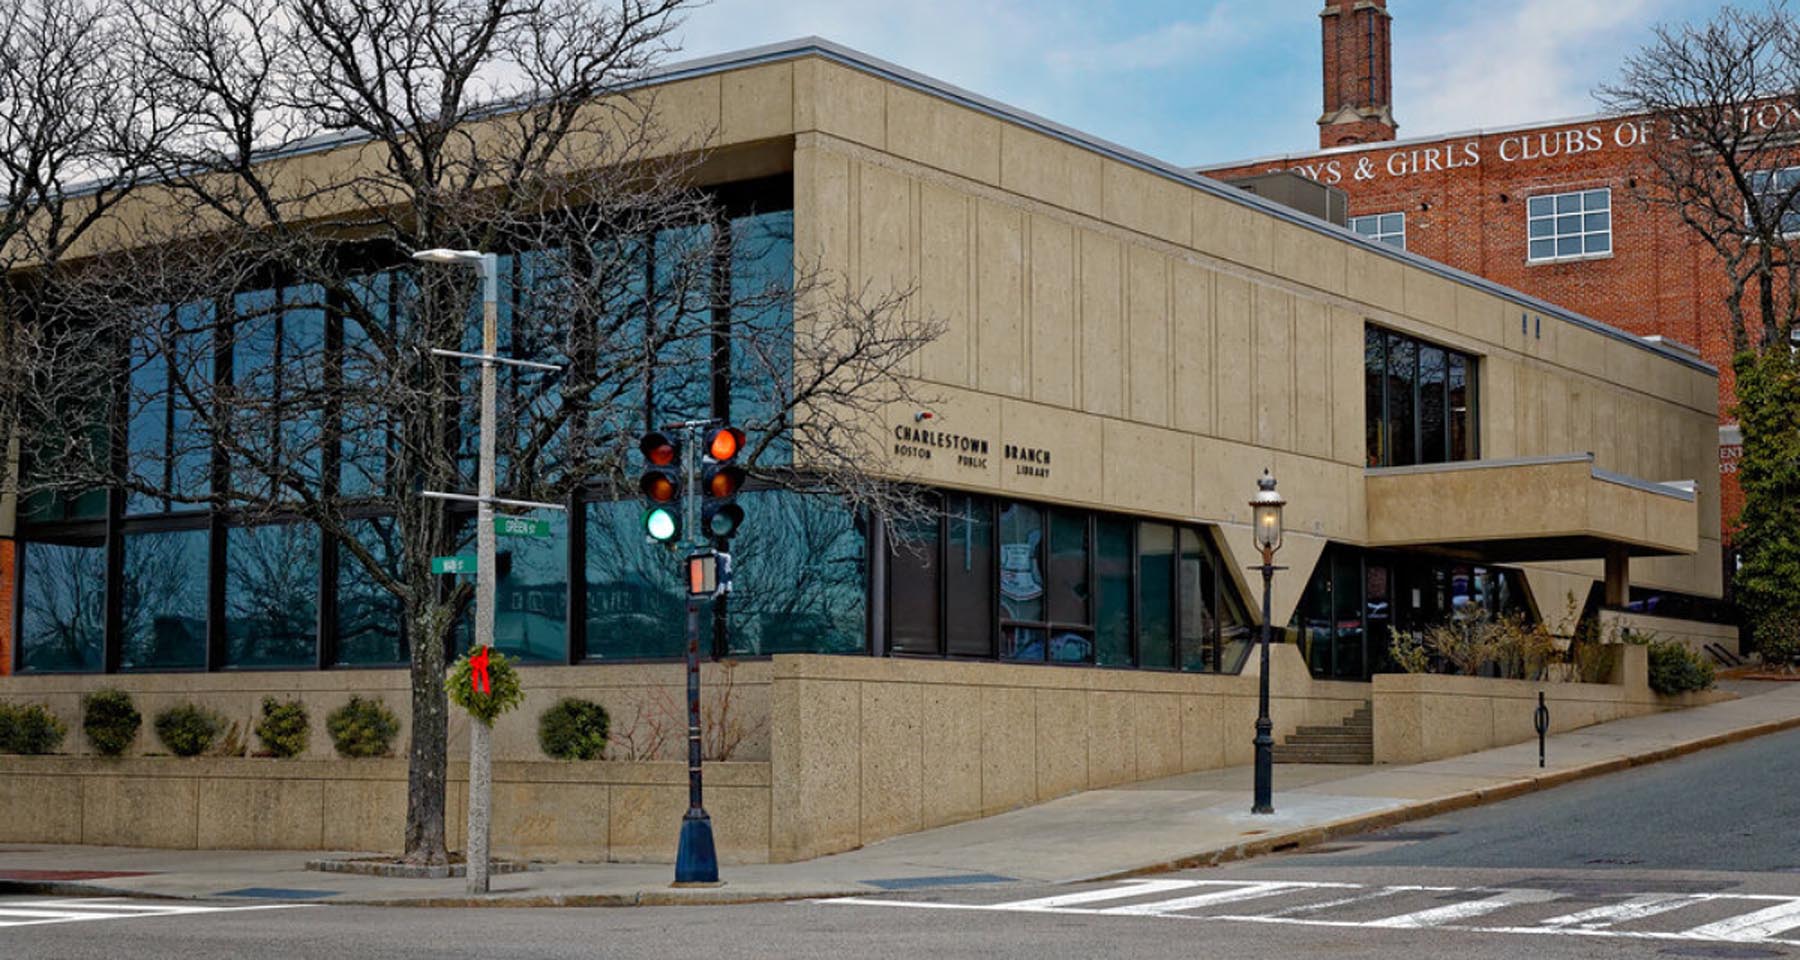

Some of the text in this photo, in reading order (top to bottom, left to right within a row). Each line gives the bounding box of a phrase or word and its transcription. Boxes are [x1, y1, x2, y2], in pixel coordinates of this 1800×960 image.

[1267, 160, 1342, 185] YS
[1354, 156, 1376, 181] &
[1386, 142, 1480, 176] GIRLS
[1499, 126, 1603, 162] CLUBS
[1614, 121, 1656, 149] OF
[895, 425, 1051, 464] CHARLESTOWN BRANCH
[895, 443, 1050, 478] BOSTON PUBLIC LIBRARY
